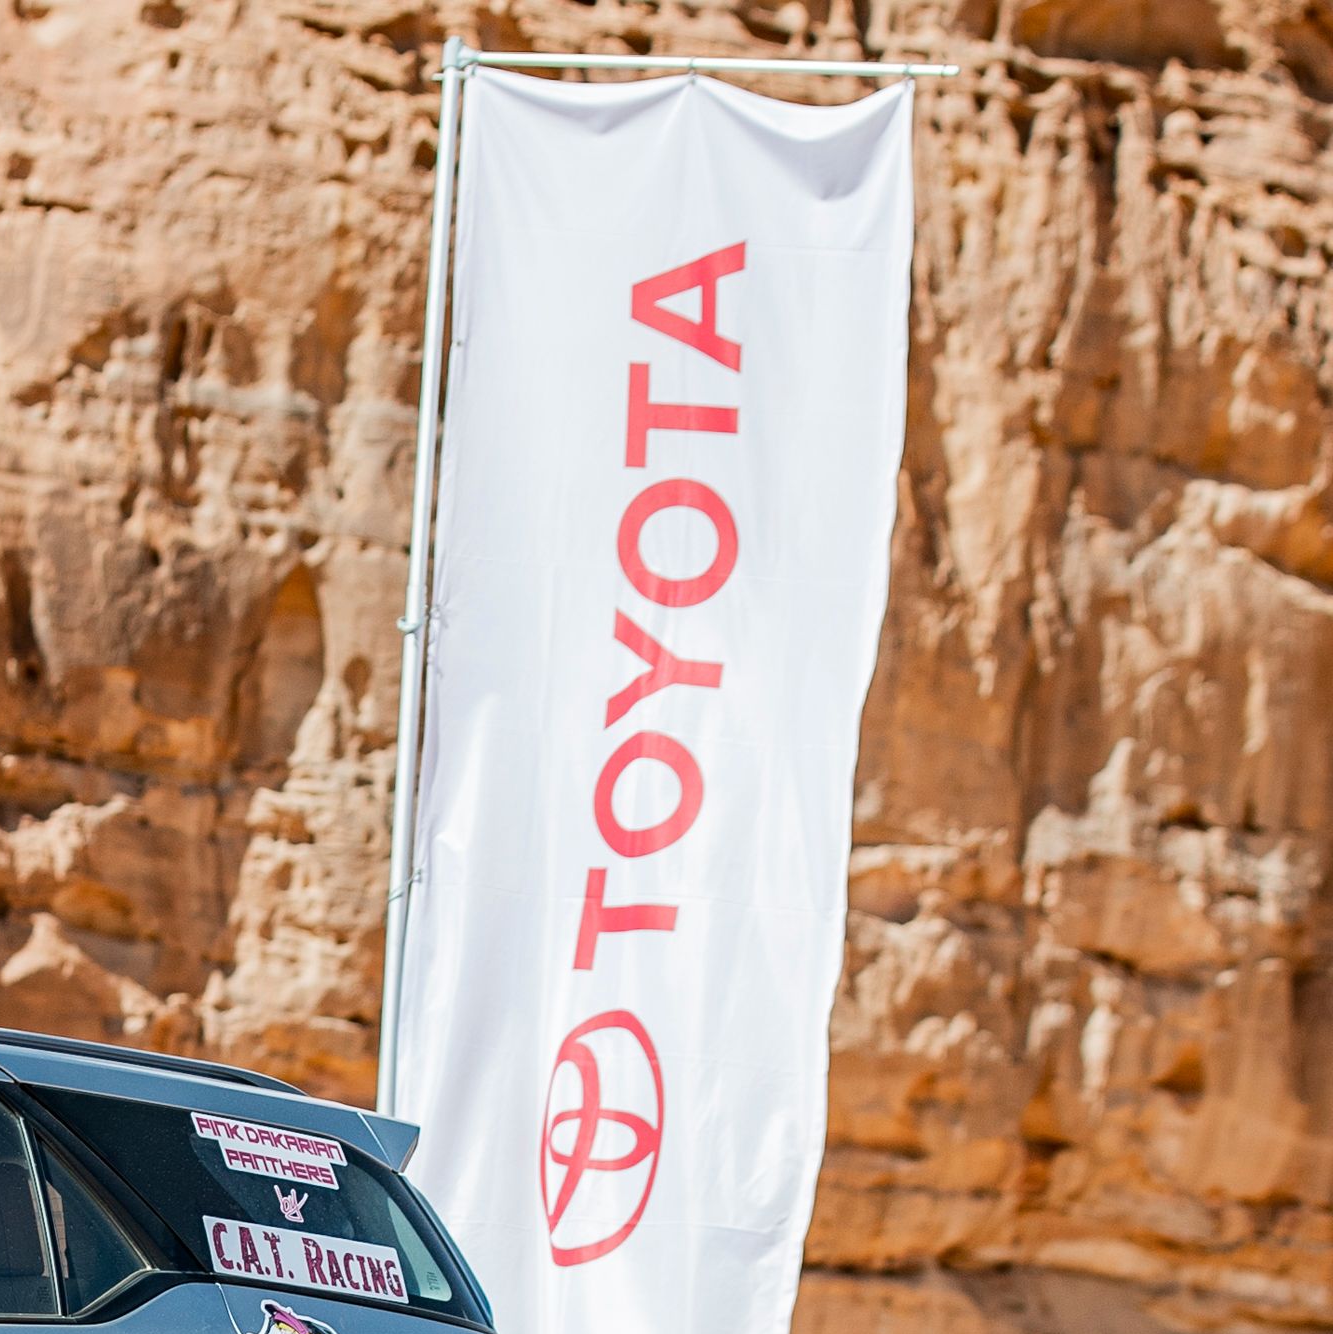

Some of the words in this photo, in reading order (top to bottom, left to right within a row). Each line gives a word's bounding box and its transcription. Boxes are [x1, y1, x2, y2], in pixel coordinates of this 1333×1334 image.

[573, 239, 749, 973] TOYOTA
[195, 1116, 245, 1142] PINK
[246, 1126, 345, 1162] DAKARIAN
[224, 1148, 335, 1185] PANTHERS
[212, 1221, 295, 1280] C.A.T.
